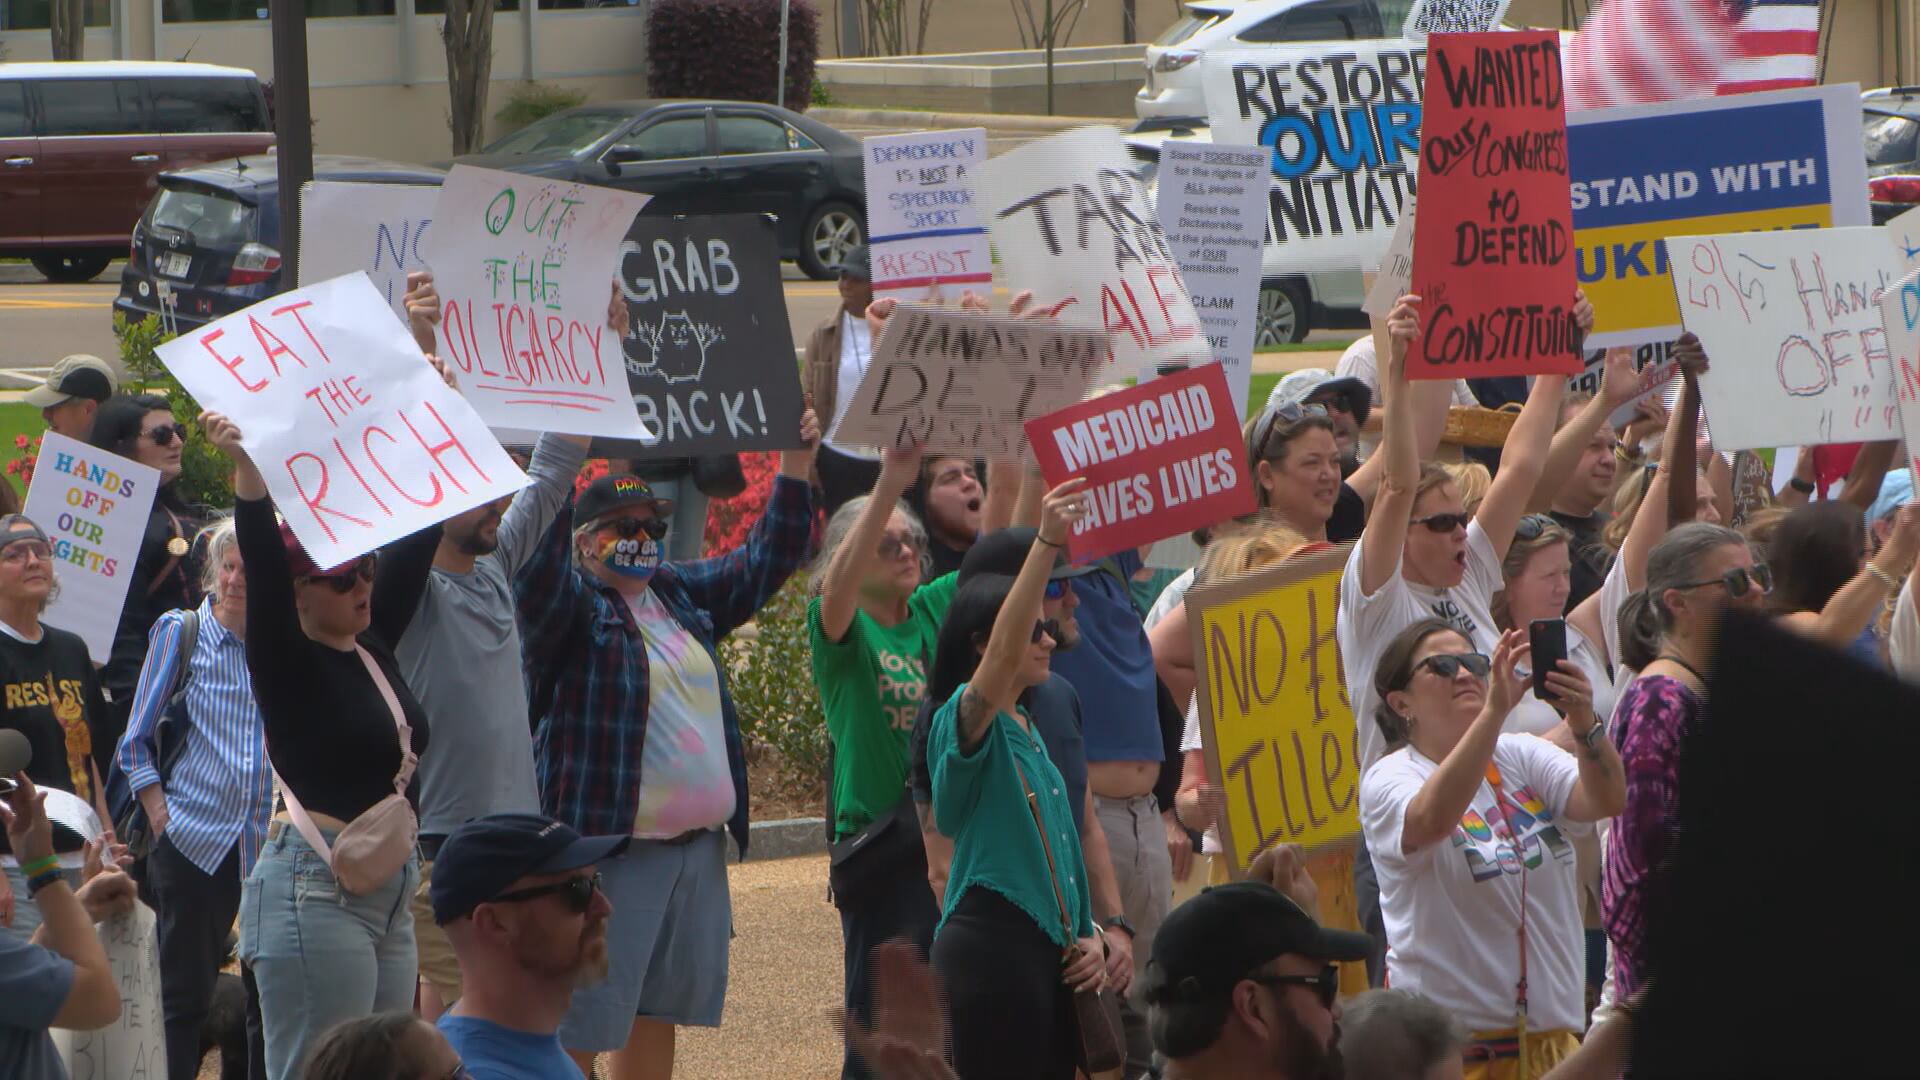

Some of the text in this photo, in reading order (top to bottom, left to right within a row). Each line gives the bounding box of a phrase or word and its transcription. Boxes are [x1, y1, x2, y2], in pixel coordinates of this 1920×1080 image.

[1437, 42, 1561, 109] WANTED
[873, 138, 976, 165] DEMOCRACY
[1168, 150, 1265, 166] Stand TOGETHER
[1257, 102, 1423, 182] OUR
[919, 165, 950, 185] NOT
[1183, 182, 1245, 196] ALL people
[1192, 167, 1210, 177] the
[1212, 169, 1243, 180] rights
[1245, 169, 1257, 180] of
[1570, 158, 1817, 210] STAND WITH
[485, 187, 584, 242] OUT
[904, 209, 961, 229] SPORT
[1178, 216, 1244, 231] Dictatorship
[1183, 202, 1241, 216] Resist this
[877, 249, 972, 277] RESIST
[1164, 233, 1259, 249] nd the plundering
[1188, 248, 1228, 262] of OUR
[1452, 219, 1568, 266] DEFEND
[484, 252, 562, 310] THE
[616, 240, 740, 302] GRAB
[200, 300, 330, 393] EAT
[442, 298, 606, 387] OLIGARCY
[895, 313, 1029, 363] HANDS
[305, 375, 372, 428] THE
[631, 388, 768, 447] BACK!
[1052, 384, 1216, 473] MEDICAID
[53, 452, 136, 498] HANDS
[285, 401, 492, 545] RICH
[1158, 448, 1238, 508] LIVES
[66, 487, 115, 518] OFF
[57, 512, 104, 546] OUR
[48, 536, 118, 578] IGHTS
[1210, 609, 1288, 721] NO
